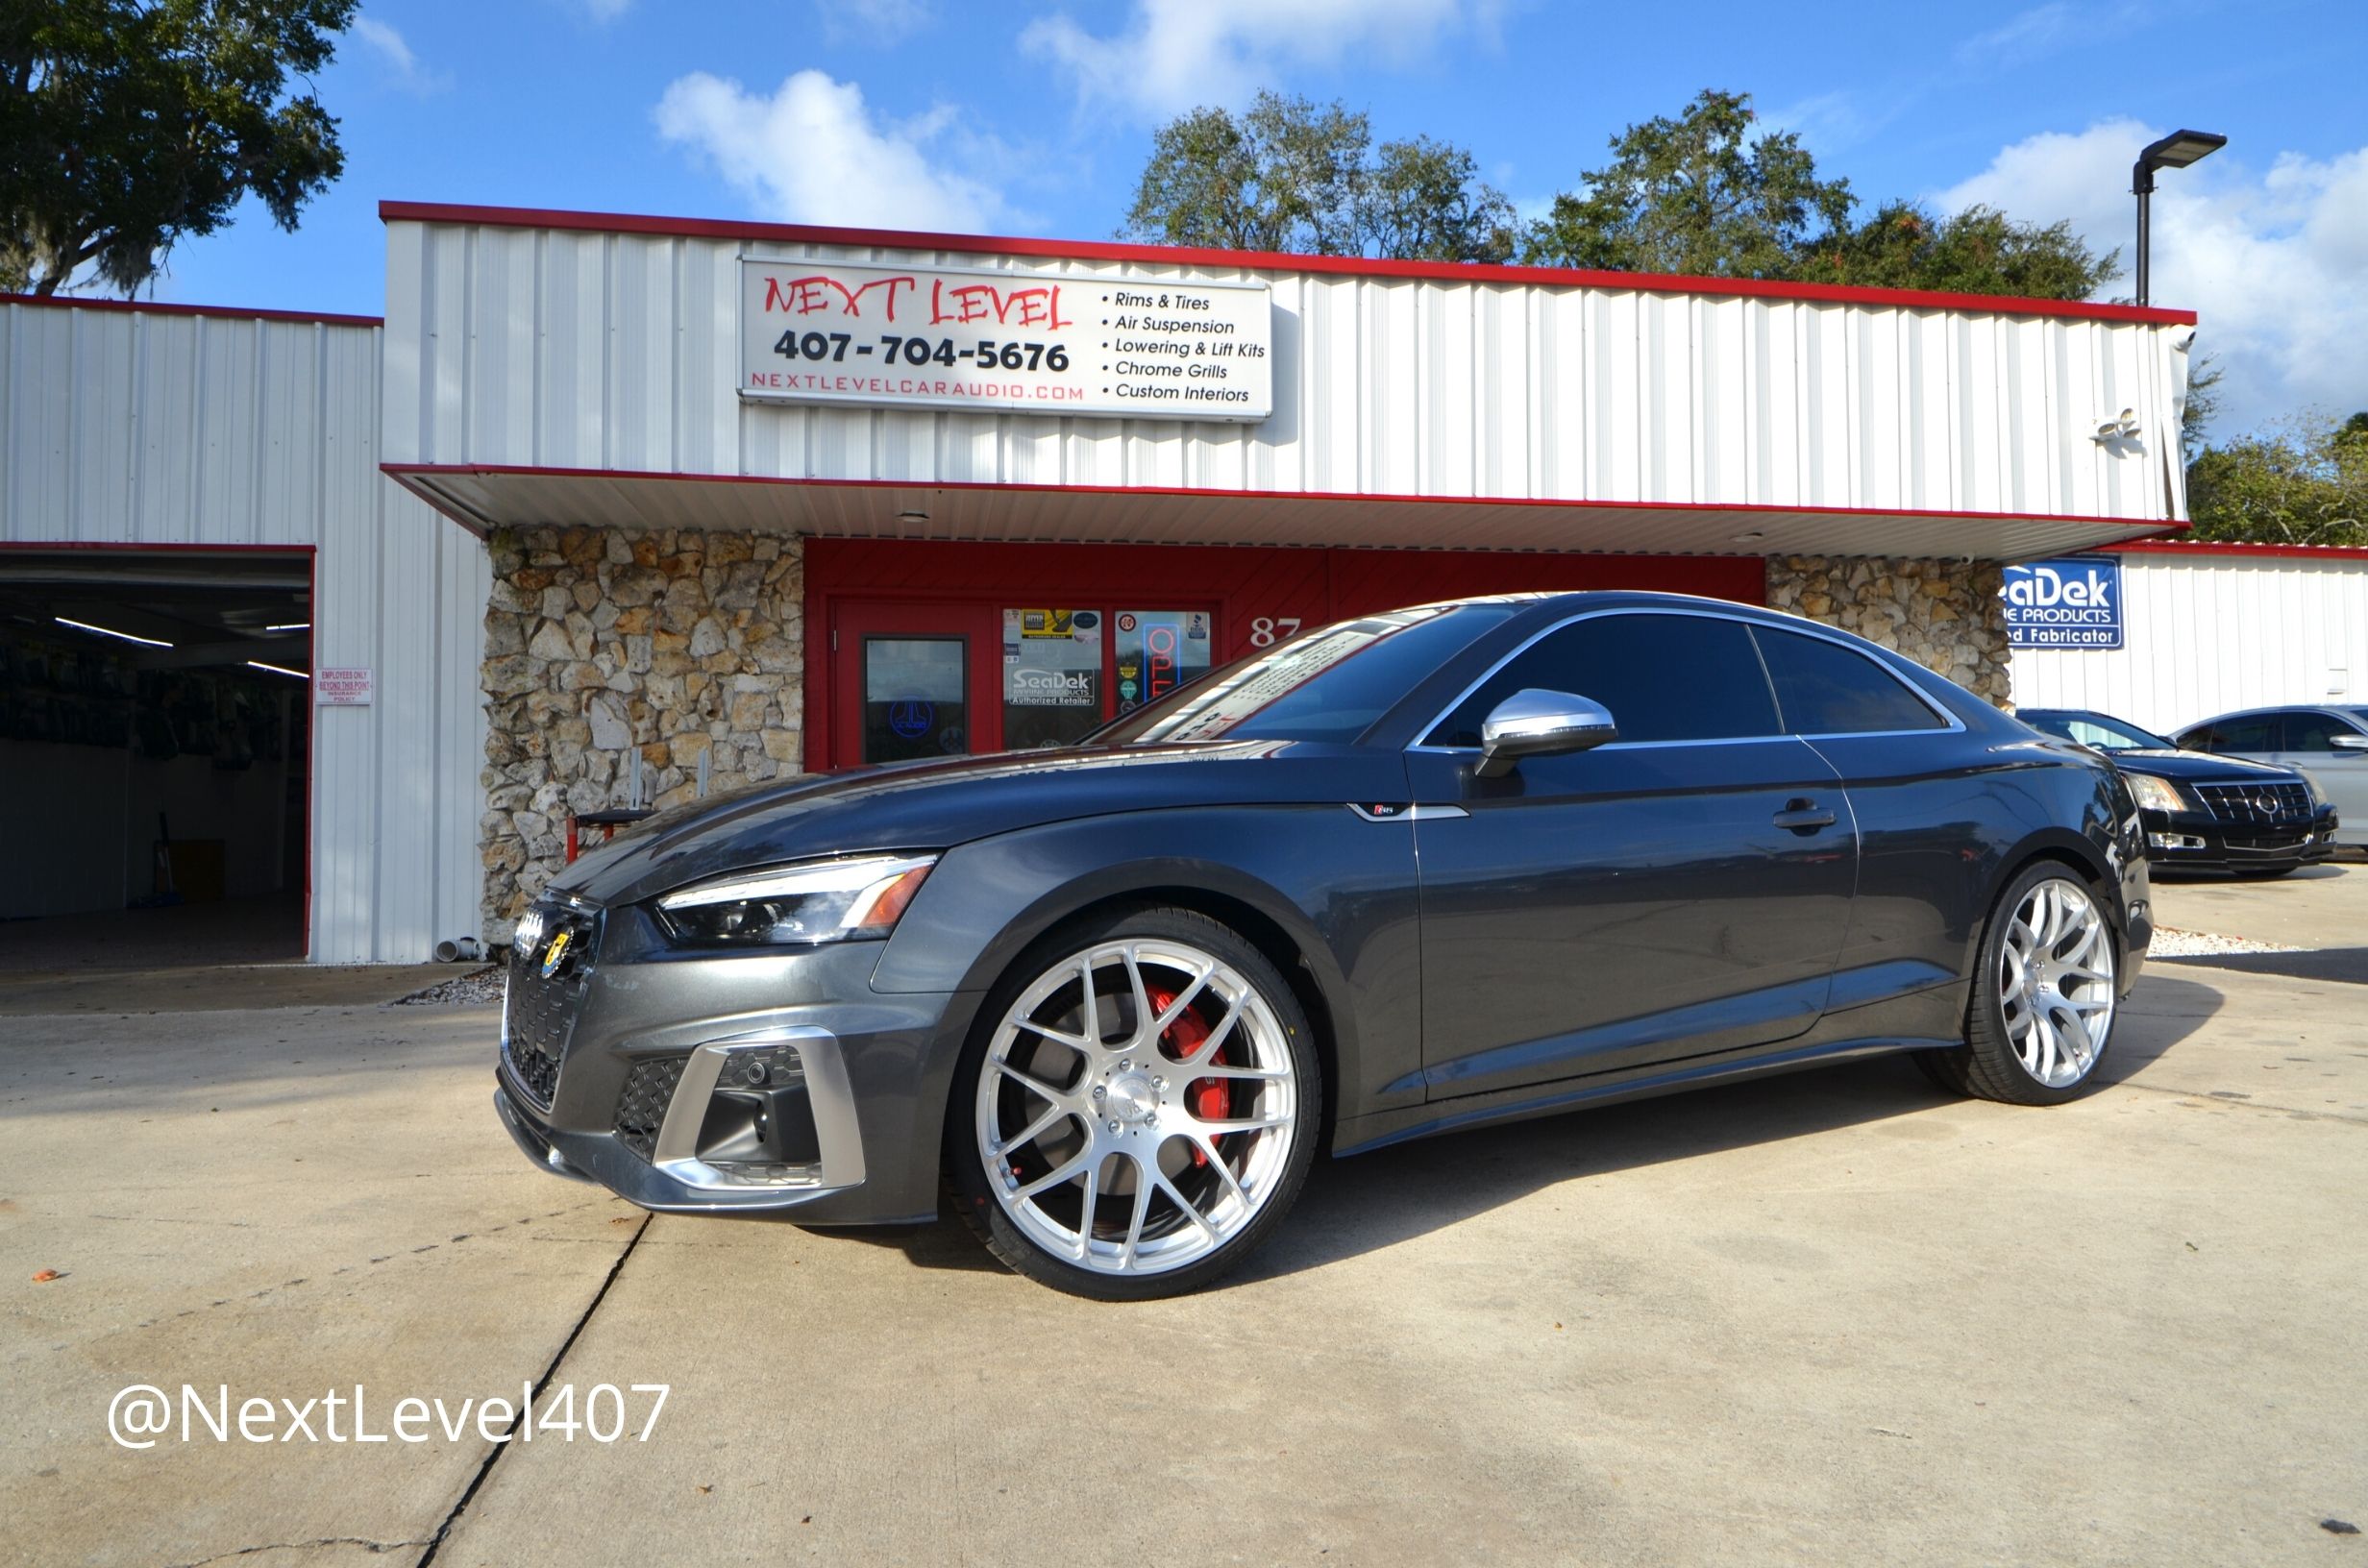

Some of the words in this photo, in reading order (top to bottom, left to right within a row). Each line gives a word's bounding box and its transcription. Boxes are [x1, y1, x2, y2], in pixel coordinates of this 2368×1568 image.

[764, 276, 915, 323] NEXT
[929, 278, 1073, 331] LEVEL
[1115, 292, 1153, 307] Rims
[1158, 294, 1170, 308] &
[1175, 295, 1210, 310] Tires
[1115, 315, 1138, 330] Air
[1142, 316, 1235, 334] Suspension
[774, 330, 1070, 372] 407-704-5676
[1115, 338, 1190, 358] Lowering
[1195, 341, 1206, 355] &
[1211, 342, 1233, 356] Lift
[1238, 343, 1265, 357] Kits
[1116, 360, 1183, 377] Chrome
[1188, 363, 1227, 379] Grills
[752, 373, 1084, 401] NEXTLEVELCARAUDIO.COM
[1116, 383, 1179, 399] Custom
[1184, 386, 1249, 402] Interiors
[1998, 565, 2110, 607] aDek
[2022, 608, 2111, 623] PRODUCTS
[1250, 617, 1301, 648] 87
[2031, 628, 2113, 643] Fabricator
[1149, 628, 1174, 698] OPE
[322, 671, 353, 679] EMPLOYEES
[354, 671, 367, 679] ONLY
[1013, 669, 1089, 689] SeaDek
[319, 681, 340, 691] BEYOND
[342, 681, 354, 691] THIS
[355, 681, 369, 691] POINT
